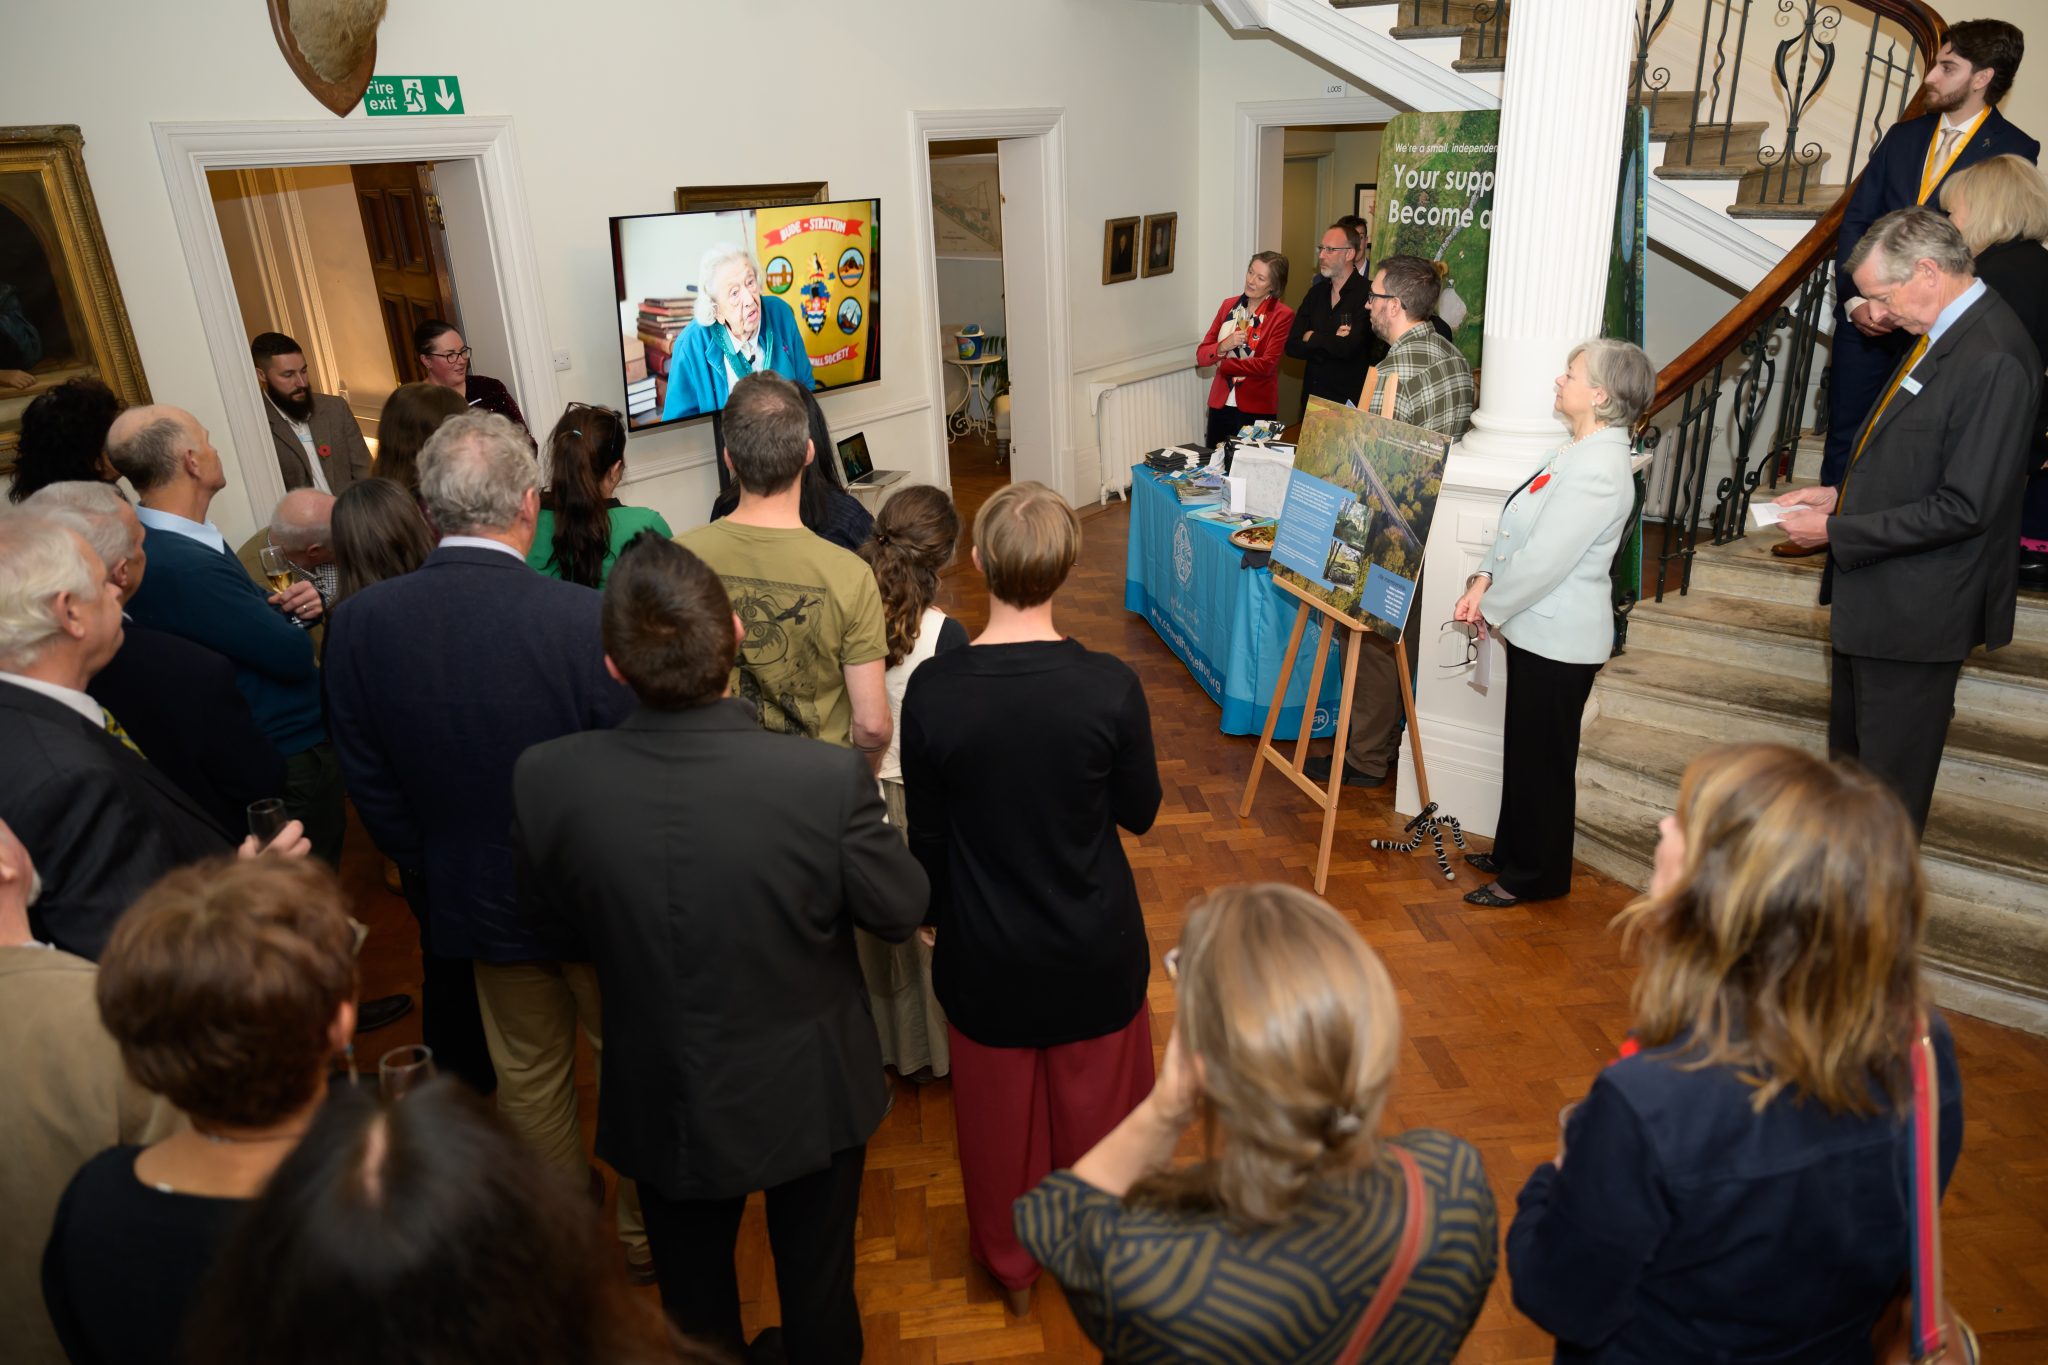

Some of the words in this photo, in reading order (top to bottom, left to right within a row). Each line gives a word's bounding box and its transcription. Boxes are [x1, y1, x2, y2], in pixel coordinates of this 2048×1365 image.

[366, 80, 394, 95] Fire
[369, 96, 398, 110] exit
[1395, 143, 1417, 153] We're
[1419, 145, 1425, 153] a
[1426, 143, 1449, 154] small,
[1393, 164, 1440, 190] Your
[1444, 170, 1495, 198] supp
[1388, 199, 1474, 228] Become
[1479, 209, 1492, 230] a
[809, 217, 847, 234] STRATTON
[824, 346, 850, 365] SOCIETY
